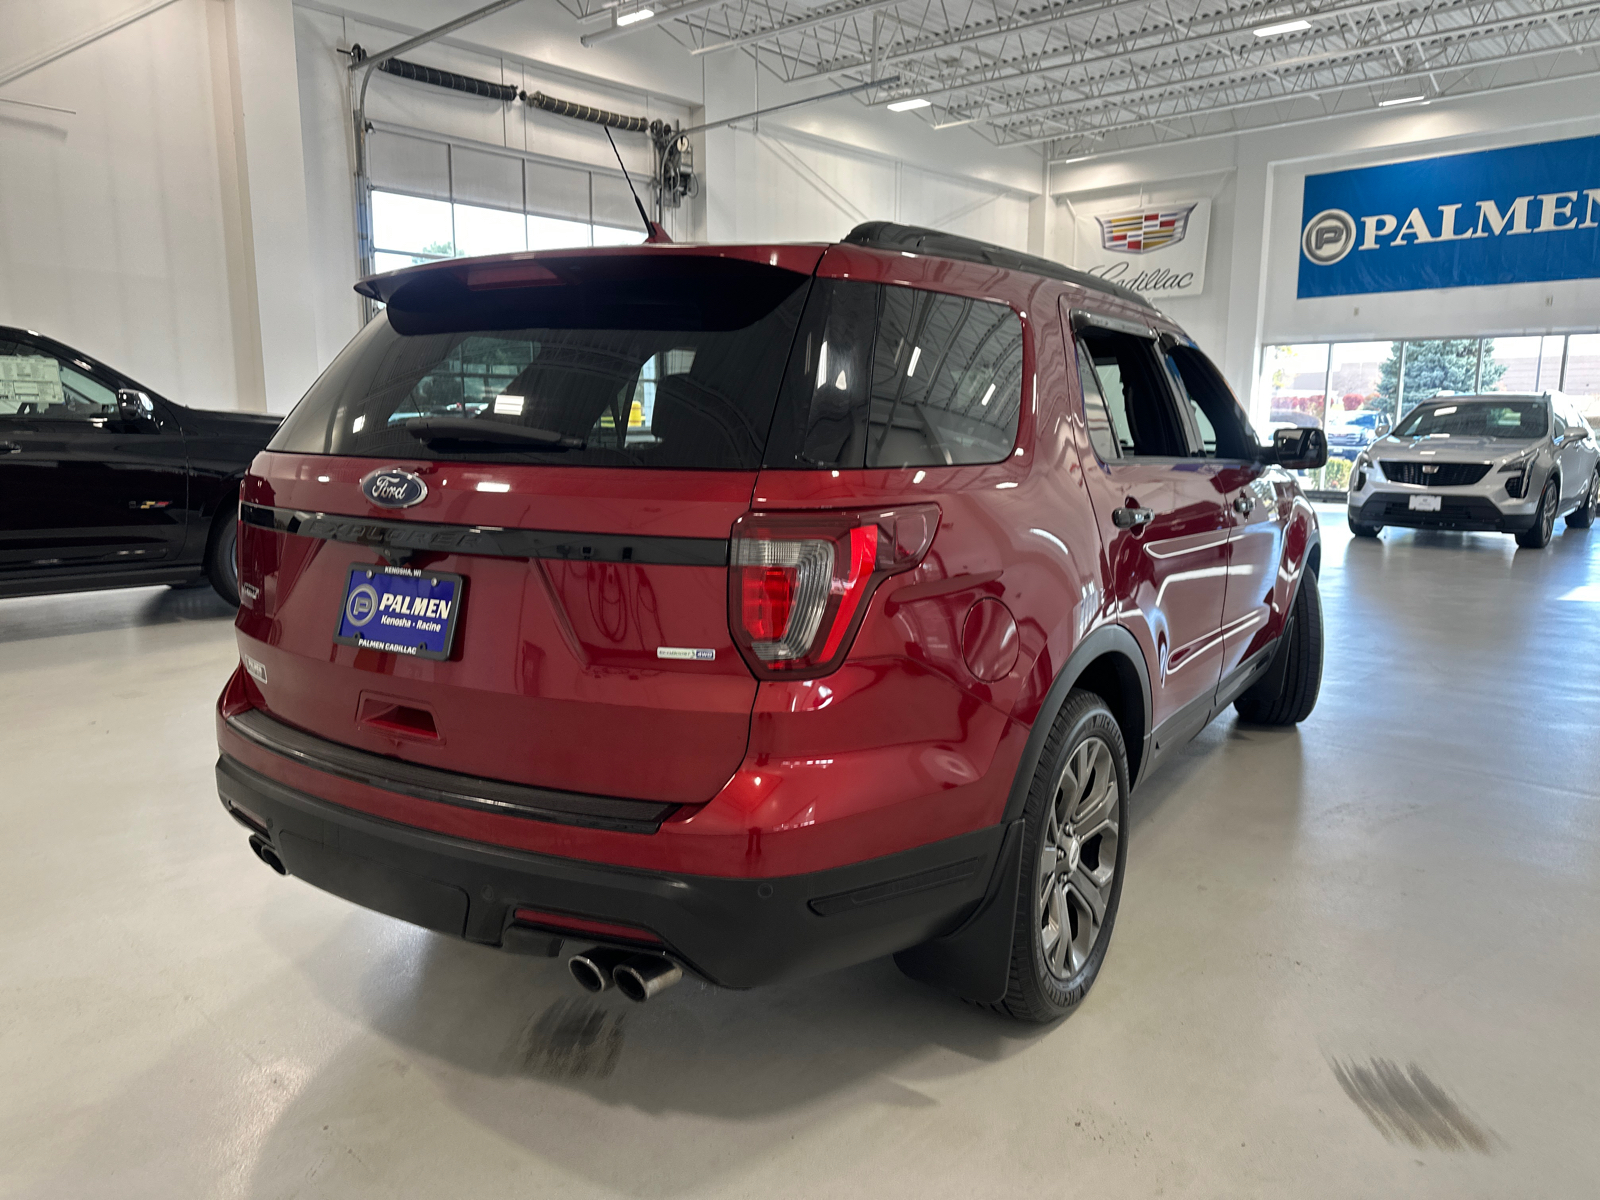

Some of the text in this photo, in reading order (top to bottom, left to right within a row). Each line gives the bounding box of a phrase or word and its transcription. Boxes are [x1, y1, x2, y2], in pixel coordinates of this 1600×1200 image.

[371, 475, 408, 500] Ford
[307, 521, 482, 548] EXPLORER
[378, 592, 452, 620] PALMEN
[381, 614, 442, 633] Kenosha Racine
[358, 638, 418, 655] PALMEN CADILLAC
[1094, 714, 1126, 757] MICHELIN
